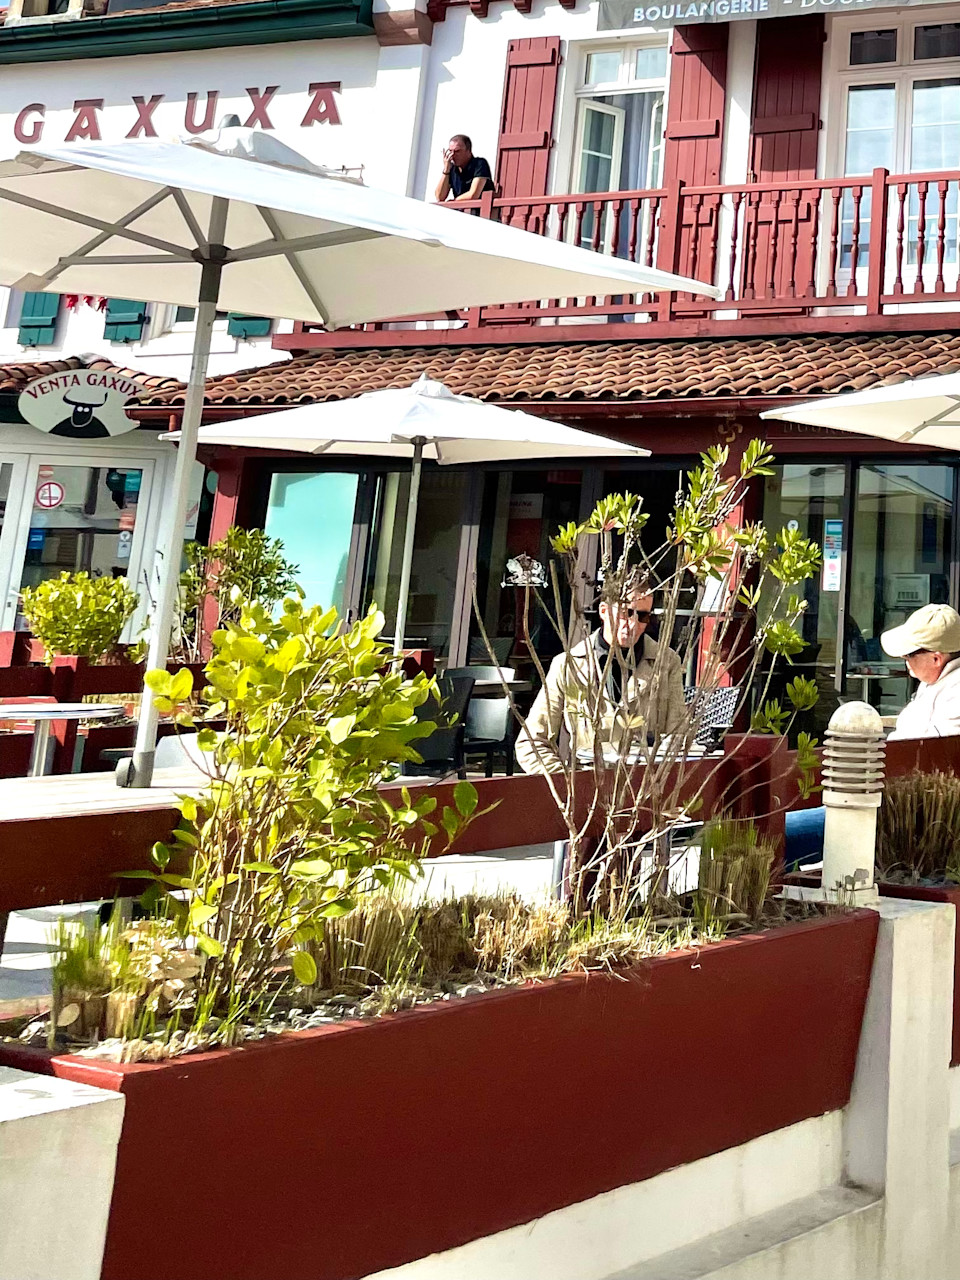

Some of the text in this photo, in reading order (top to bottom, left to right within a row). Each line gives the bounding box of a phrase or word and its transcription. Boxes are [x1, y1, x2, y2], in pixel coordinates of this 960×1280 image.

[13, 80, 344, 145] GAXUXA
[26, 373, 143, 399] VENTA GAXUX
